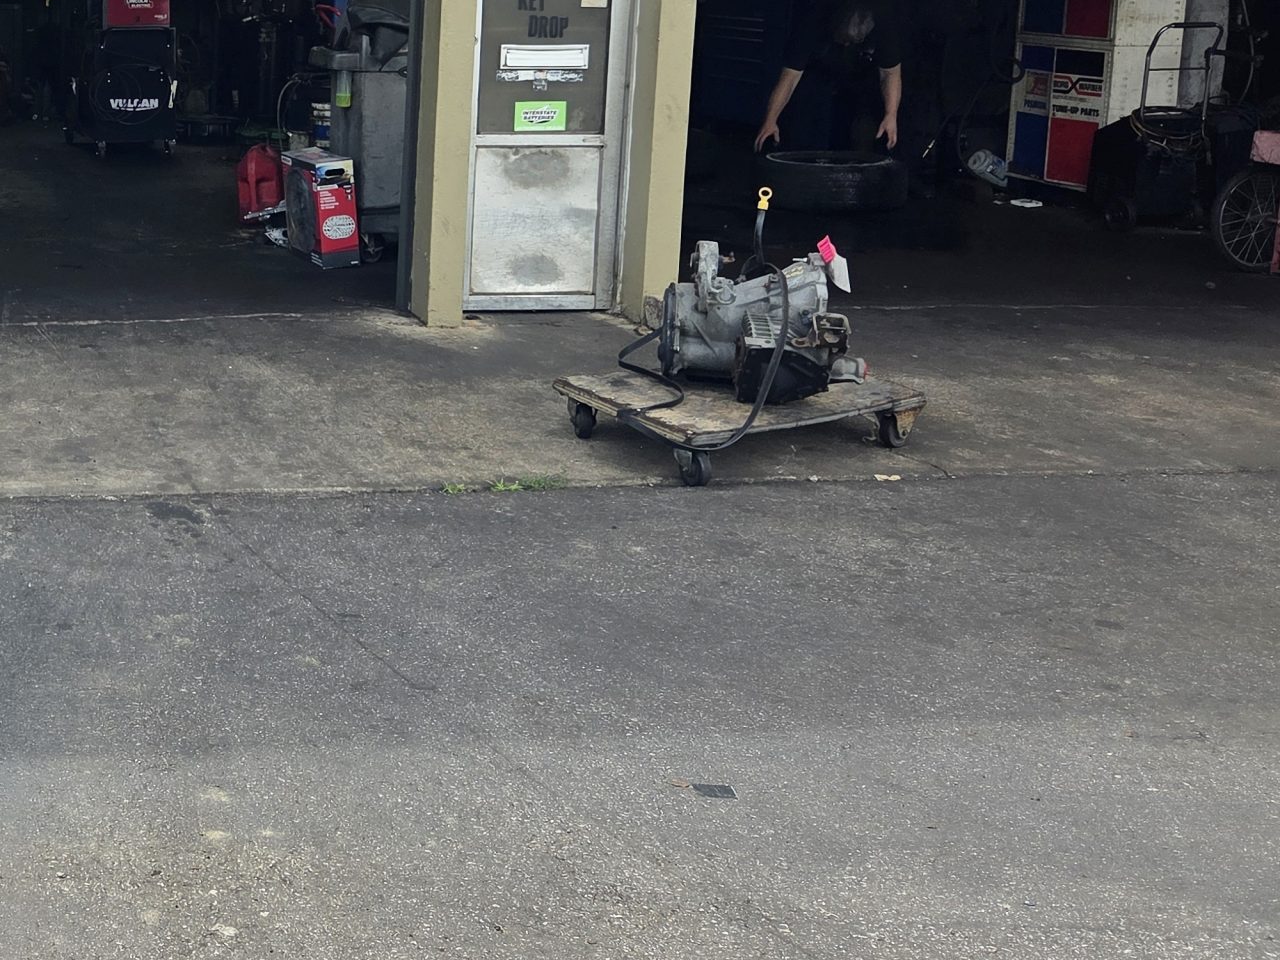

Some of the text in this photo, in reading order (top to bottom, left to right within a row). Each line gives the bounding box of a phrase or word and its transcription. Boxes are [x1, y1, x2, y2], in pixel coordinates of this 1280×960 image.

[527, 14, 569, 38] DROP
[109, 98, 159, 109] VULCAN
[1080, 107, 1099, 117] PARTS
